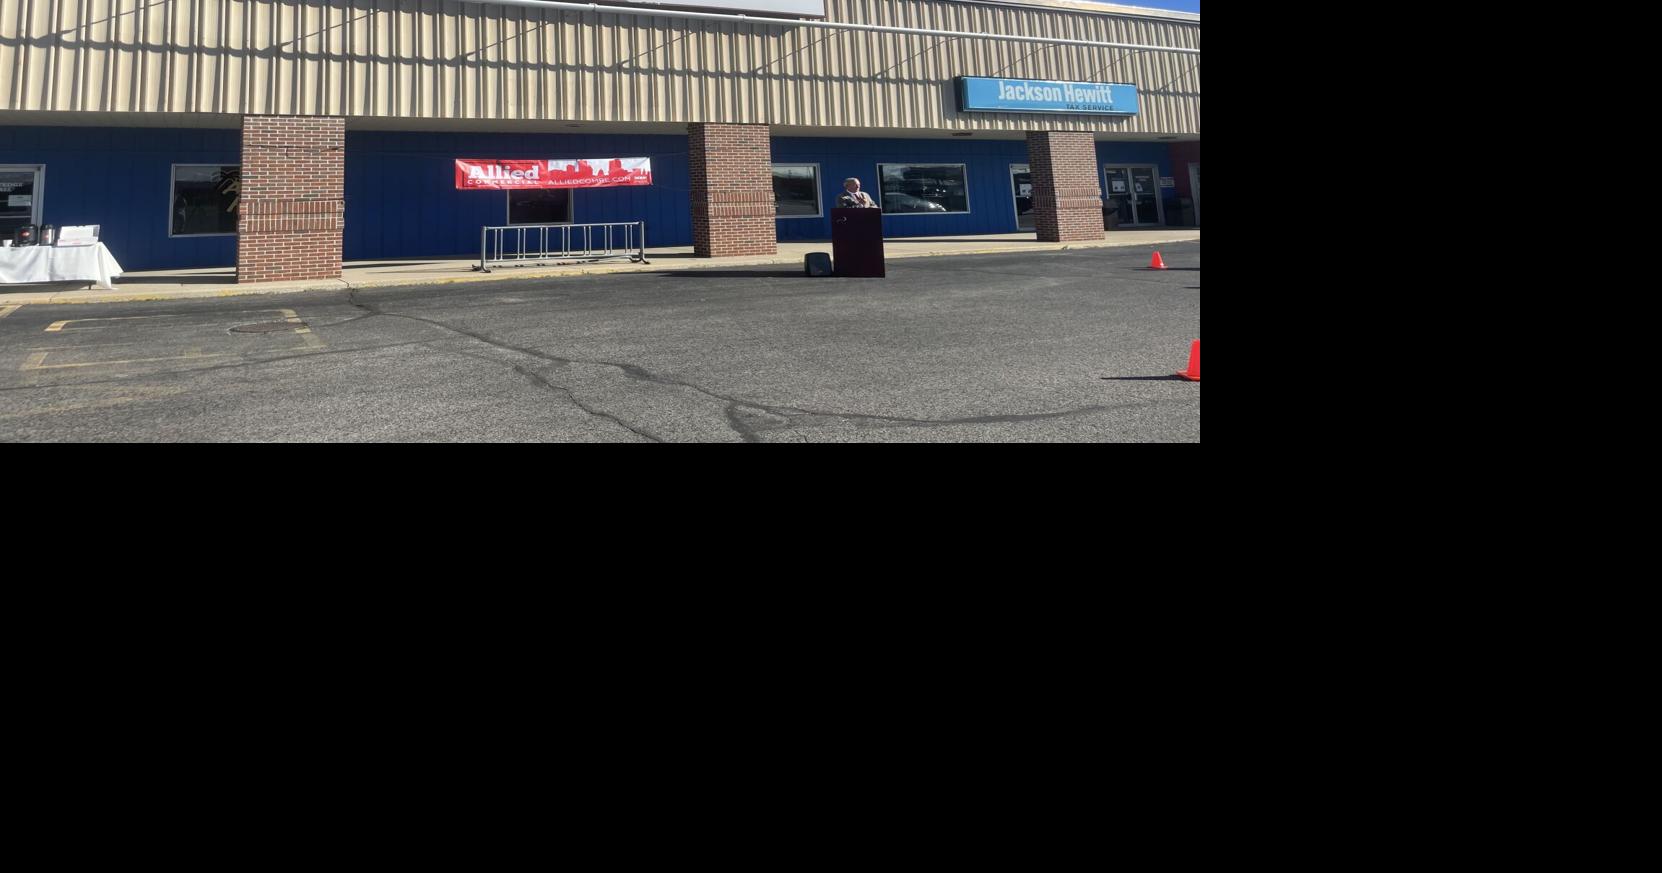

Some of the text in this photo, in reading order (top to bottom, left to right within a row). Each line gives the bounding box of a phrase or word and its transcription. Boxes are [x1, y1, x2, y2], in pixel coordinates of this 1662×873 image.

[998, 81, 1112, 103] Jackson Hewitt
[468, 165, 539, 179] Allied
